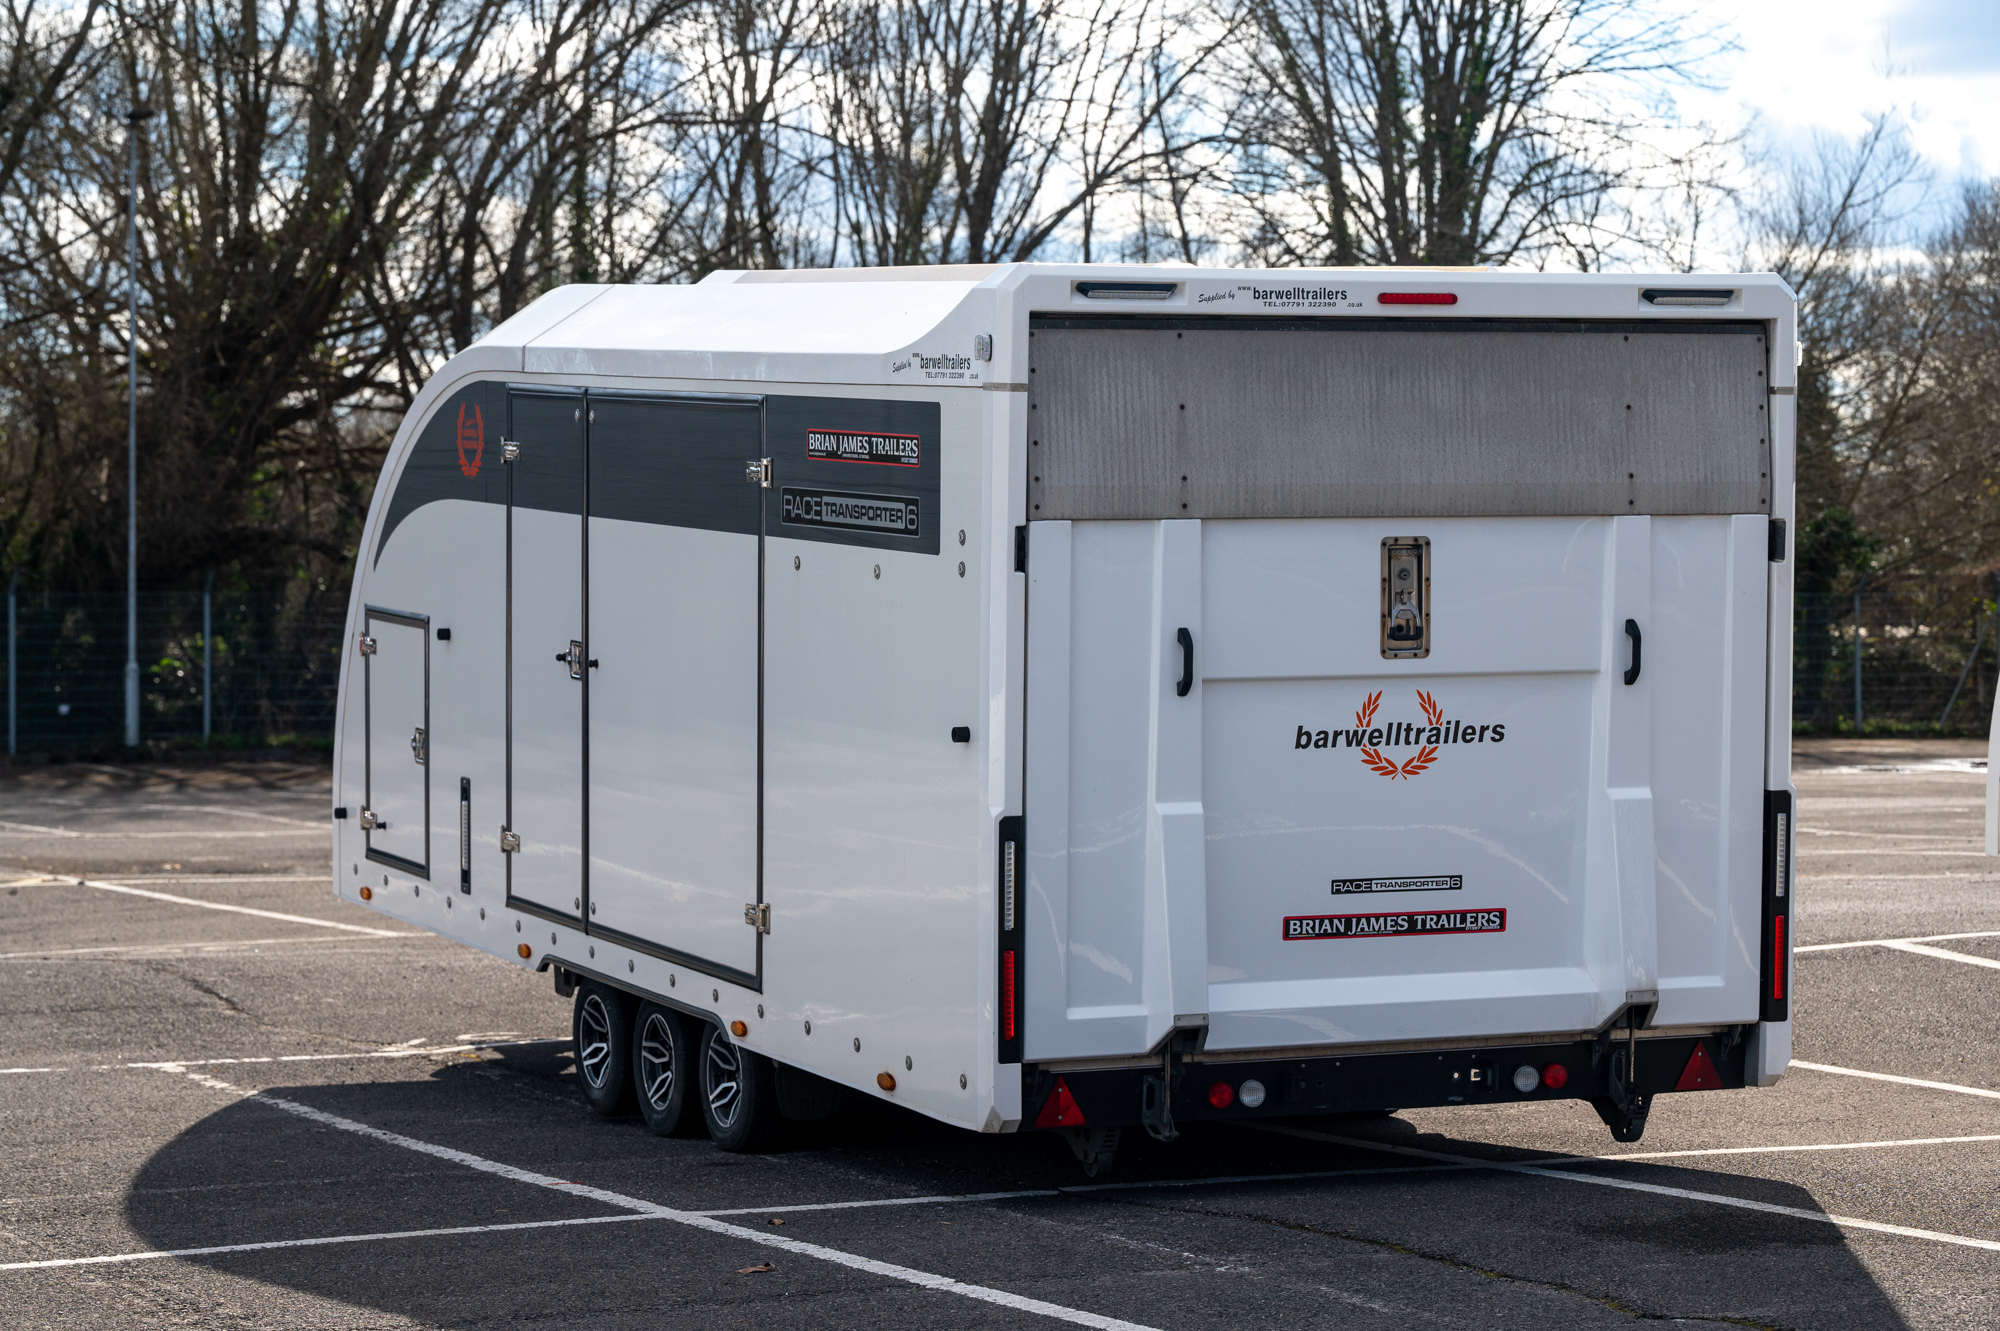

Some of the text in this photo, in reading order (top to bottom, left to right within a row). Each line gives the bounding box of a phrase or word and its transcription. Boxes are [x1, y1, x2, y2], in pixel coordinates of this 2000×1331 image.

[1198, 292, 1227, 304] Supplied
[1228, 290, 1236, 301] by
[1253, 287, 1348, 300] barwelltrailers
[920, 354, 970, 369] barwelltrailers
[808, 433, 919, 457] BRIAN JAMES TRAILERS
[783, 494, 918, 530] RACE TRANSPORTER 6
[1295, 720, 1505, 749] barwelltrailers
[1333, 877, 1461, 892] RACE TRANSPORTER 6
[1289, 912, 1500, 935] BRIAN JAMES TRAILERS
